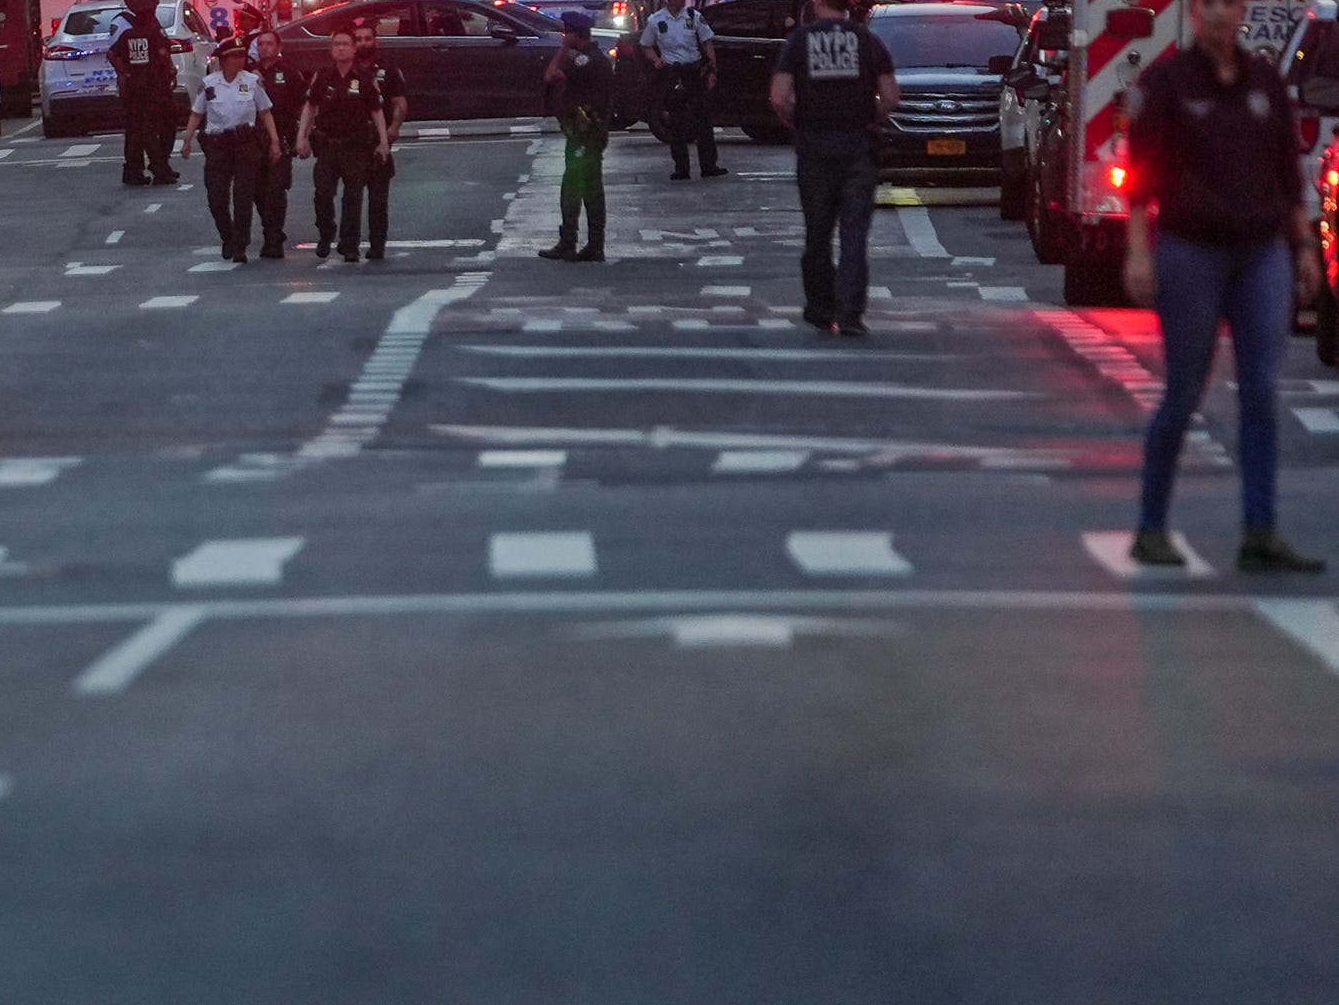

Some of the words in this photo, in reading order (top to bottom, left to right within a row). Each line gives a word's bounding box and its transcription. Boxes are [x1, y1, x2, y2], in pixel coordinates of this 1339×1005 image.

[209, 7, 230, 30] 8
[127, 37, 149, 51] NYPD
[807, 31, 859, 53] NYPD
[129, 50, 149, 61] POLICE
[808, 52, 859, 70] POLICE
